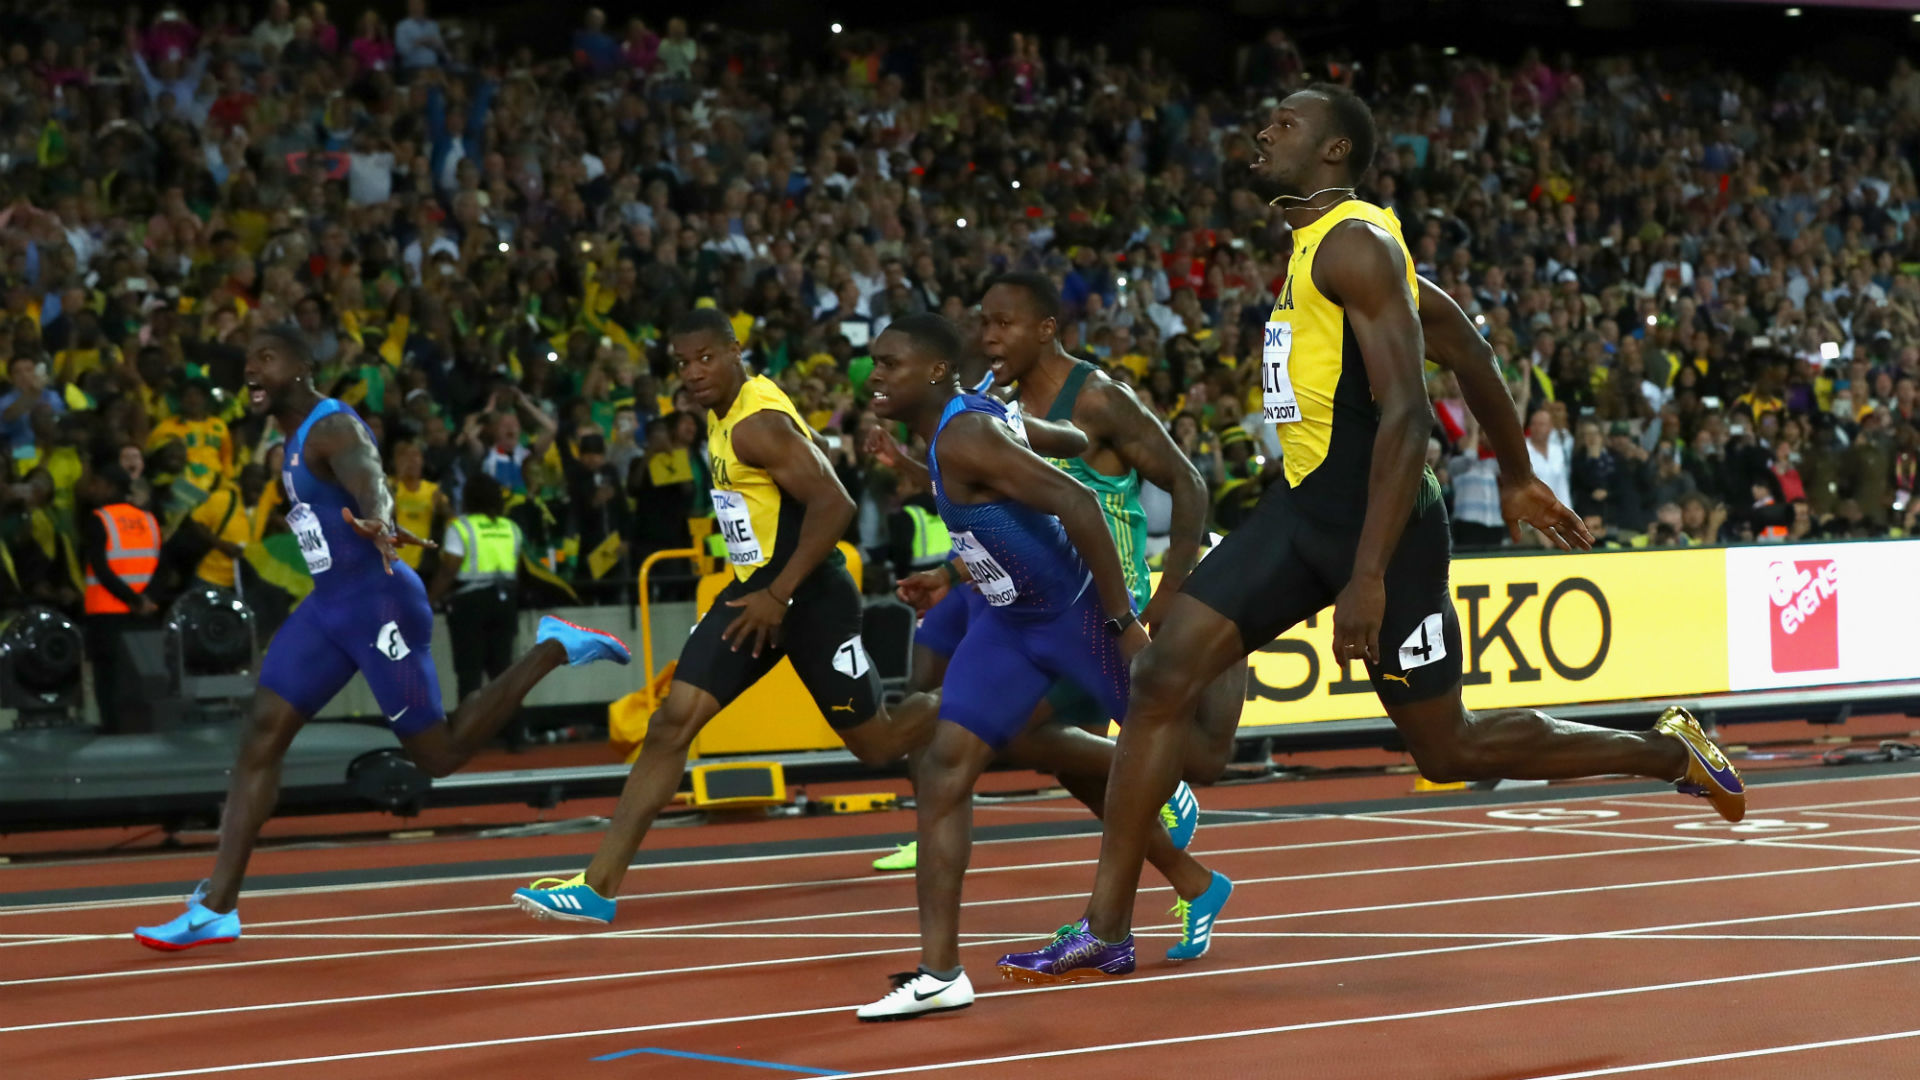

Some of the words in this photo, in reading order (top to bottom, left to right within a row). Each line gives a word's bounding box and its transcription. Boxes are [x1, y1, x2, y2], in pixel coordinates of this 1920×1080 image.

[1274, 405, 1296, 419] 2017
[1412, 622, 1432, 661] 4
[841, 644, 857, 675] 7
